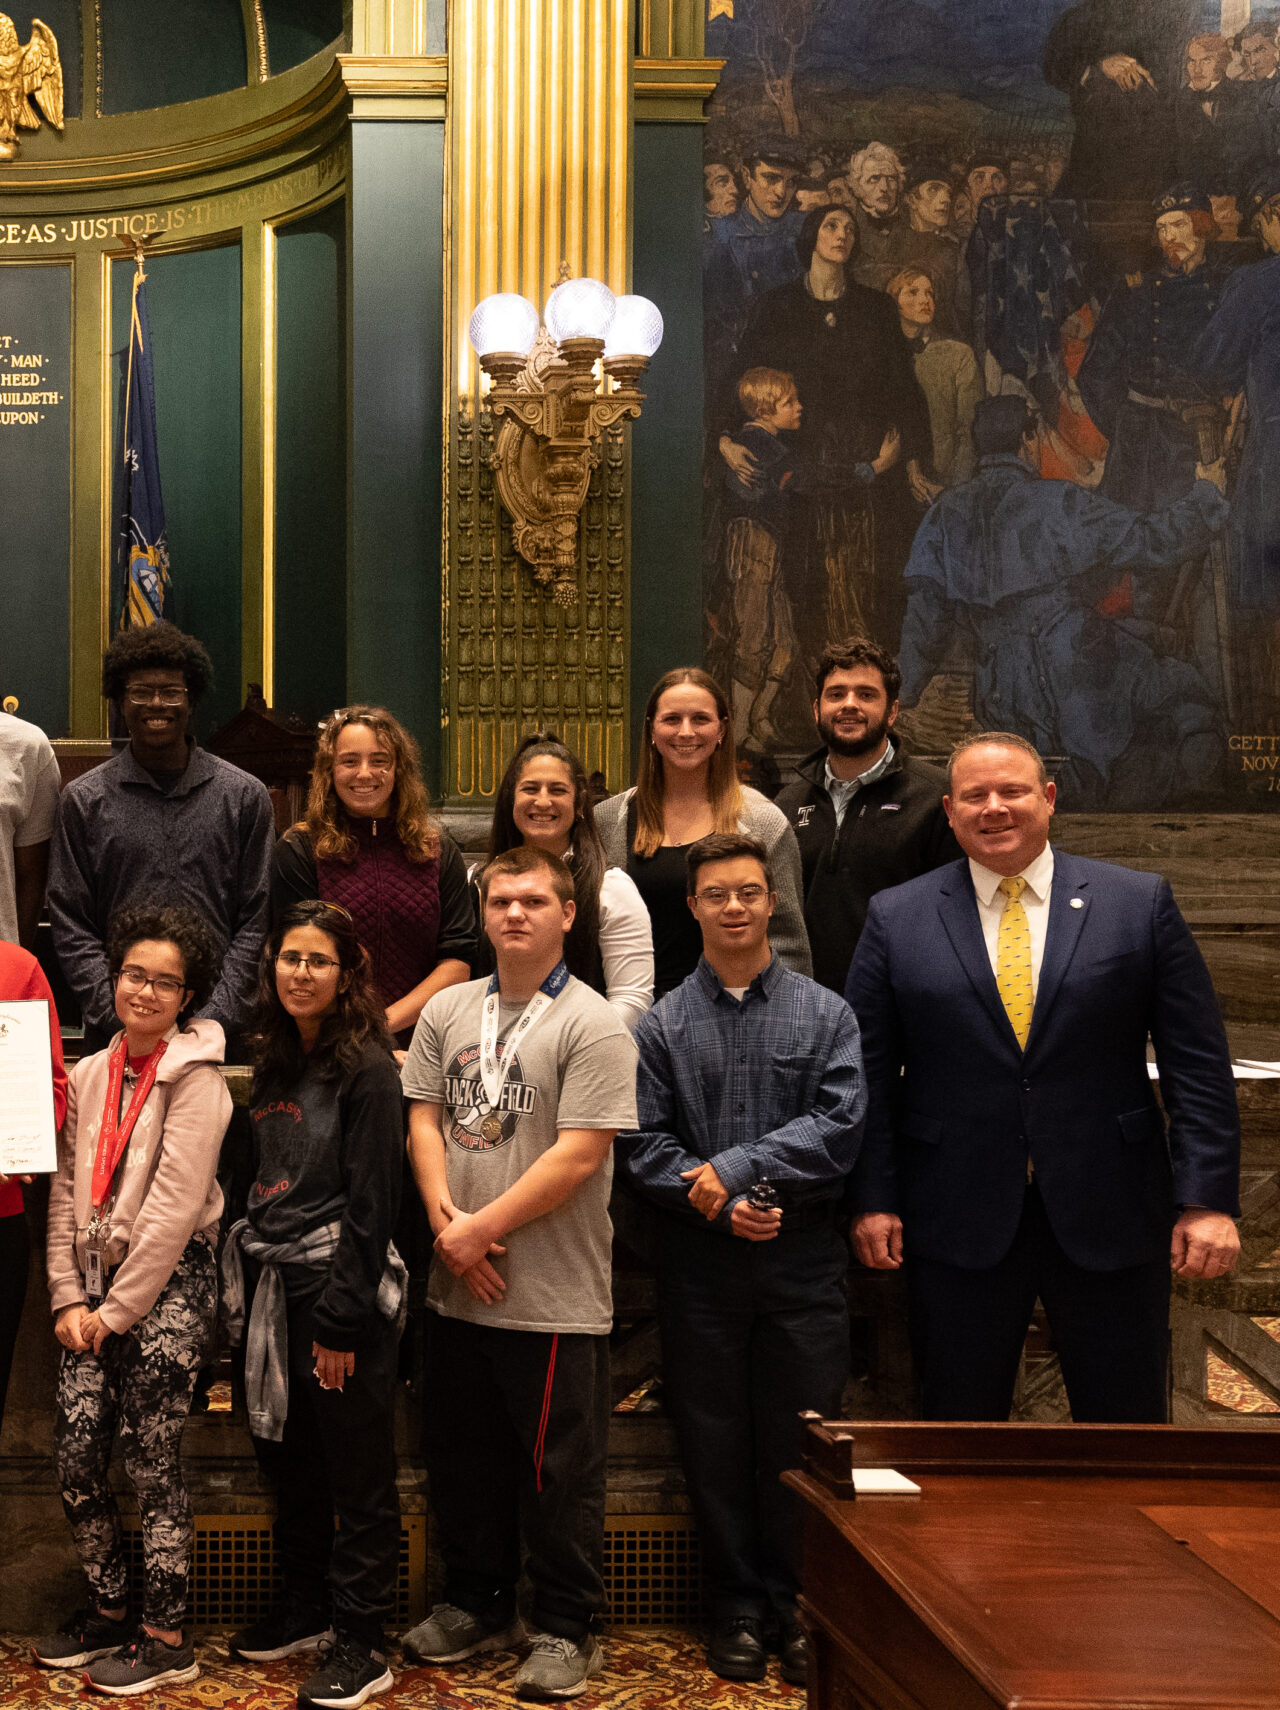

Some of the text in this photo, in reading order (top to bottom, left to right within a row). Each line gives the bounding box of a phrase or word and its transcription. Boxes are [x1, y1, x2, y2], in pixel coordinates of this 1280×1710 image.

[25, 223, 57, 243] AS
[65, 213, 158, 241] JUSTICE
[167, 208, 185, 230] IS
[10, 354, 42, 367] MAN
[1, 374, 40, 386] HEED
[798, 805, 816, 826] T
